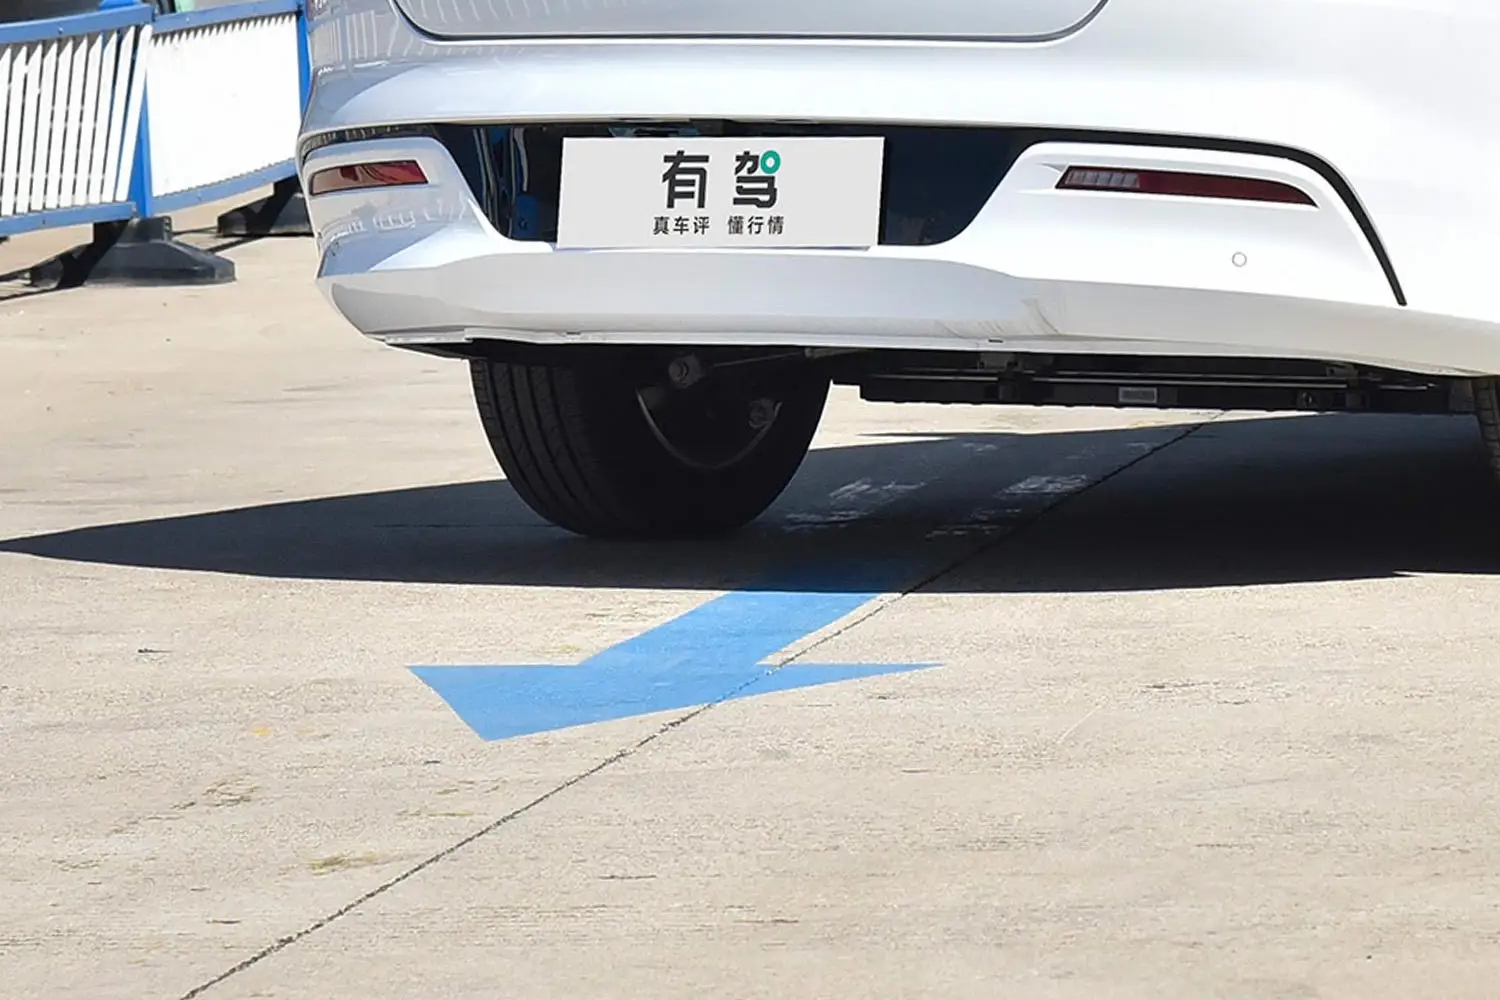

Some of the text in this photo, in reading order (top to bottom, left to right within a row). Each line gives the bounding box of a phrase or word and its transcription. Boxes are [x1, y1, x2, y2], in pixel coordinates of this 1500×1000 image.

[661, 150, 781, 209] 有驾
[652, 215, 784, 236] 真车评 懂行情
